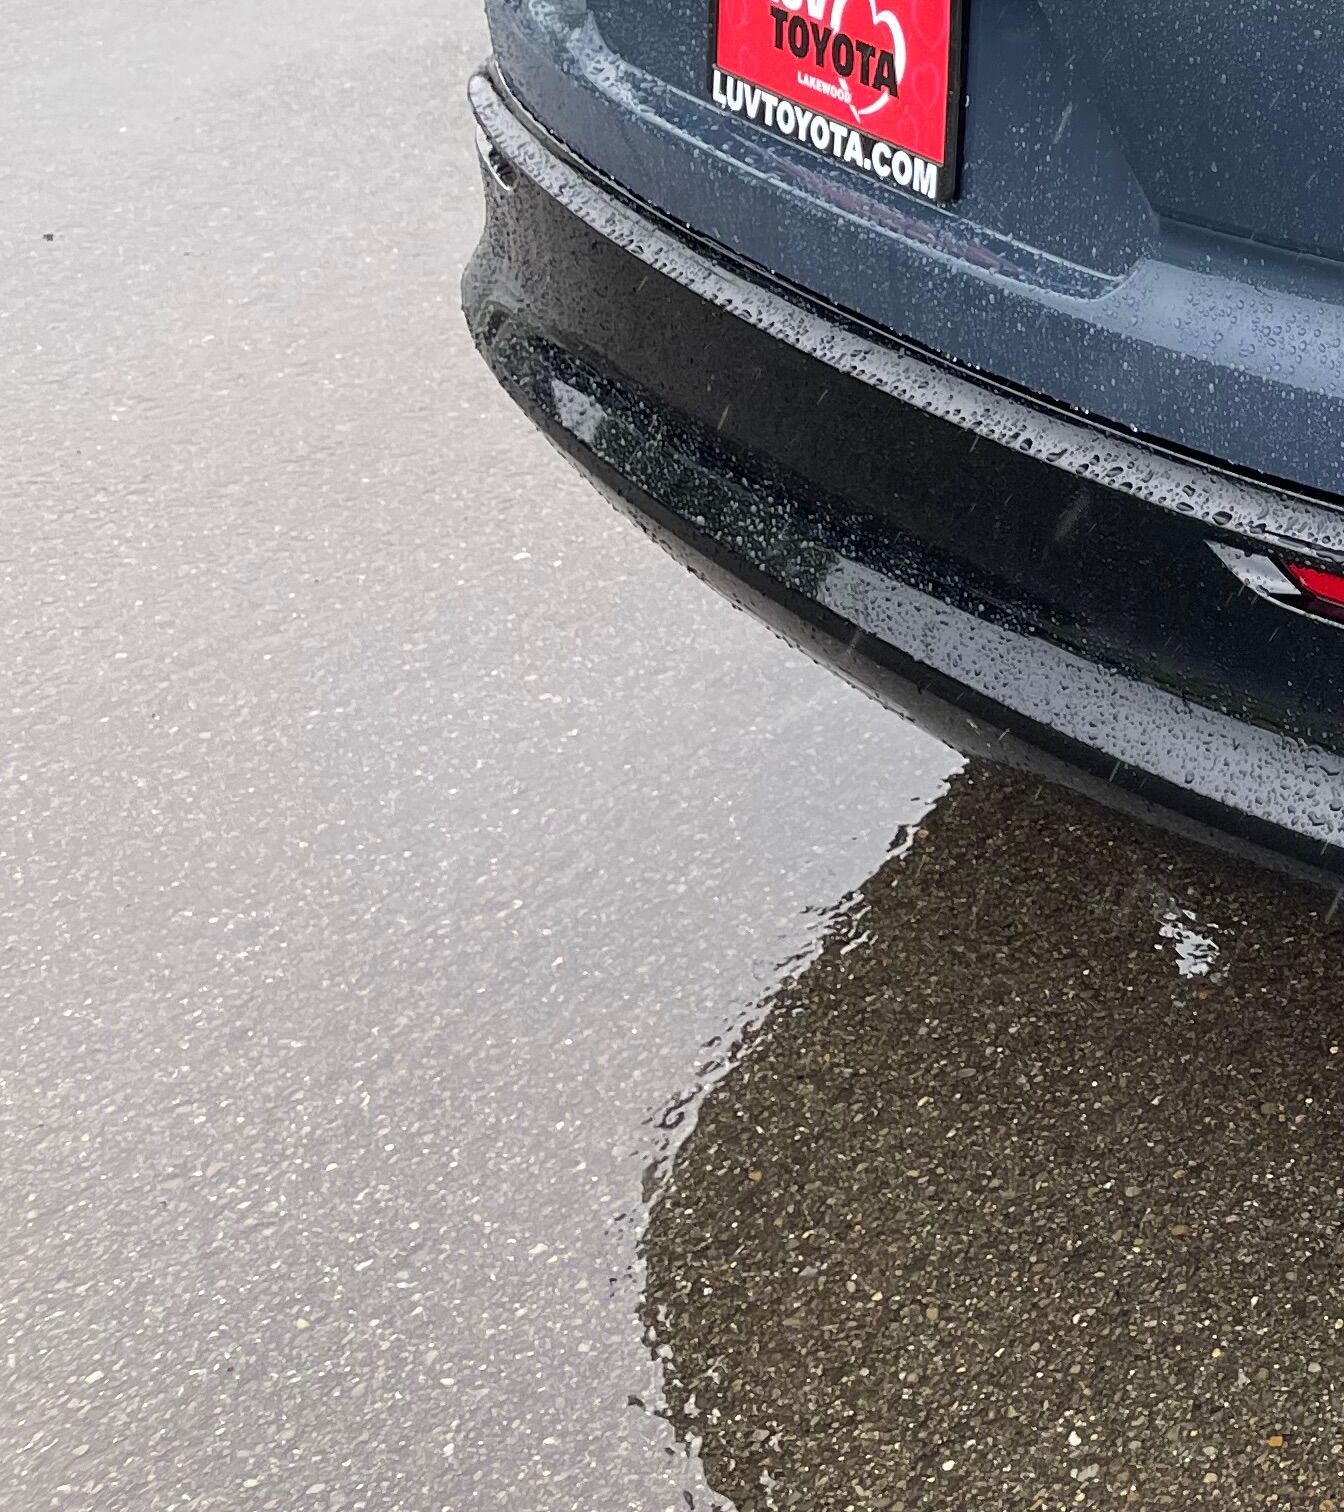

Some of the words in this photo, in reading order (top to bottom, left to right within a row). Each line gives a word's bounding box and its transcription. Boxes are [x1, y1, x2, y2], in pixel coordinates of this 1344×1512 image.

[770, 5, 899, 99] TOYOTA
[797, 71, 852, 104] LAKEWOOD
[712, 69, 938, 199] LUVTOYOTA.COM
